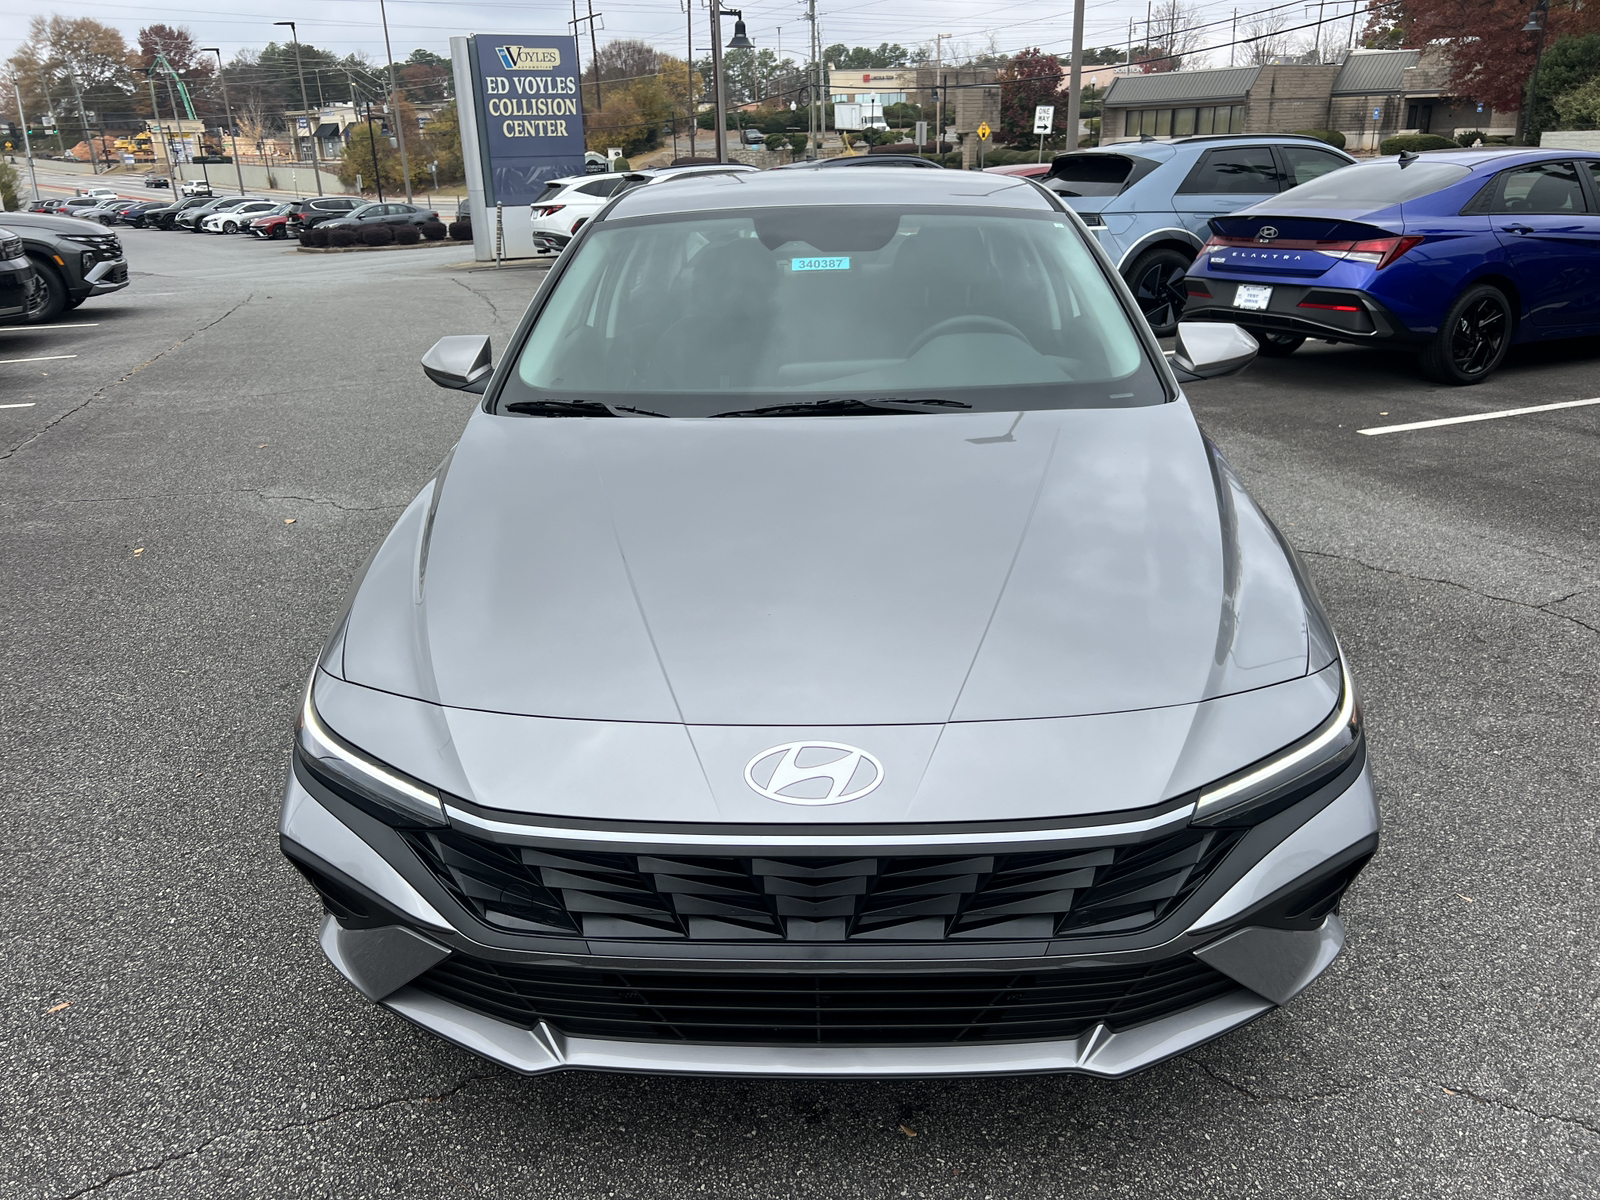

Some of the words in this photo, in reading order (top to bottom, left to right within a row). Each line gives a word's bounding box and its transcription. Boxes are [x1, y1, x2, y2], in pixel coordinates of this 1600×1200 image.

[505, 46, 556, 66] VOYLES
[486, 76, 509, 94] ED
[513, 76, 576, 94] VOYLES
[489, 98, 577, 116] COLLISION
[1038, 107, 1051, 115] ONE
[502, 120, 568, 137] CENTER
[798, 260, 843, 269] 340387
[1232, 252, 1301, 260] ELANTRA
